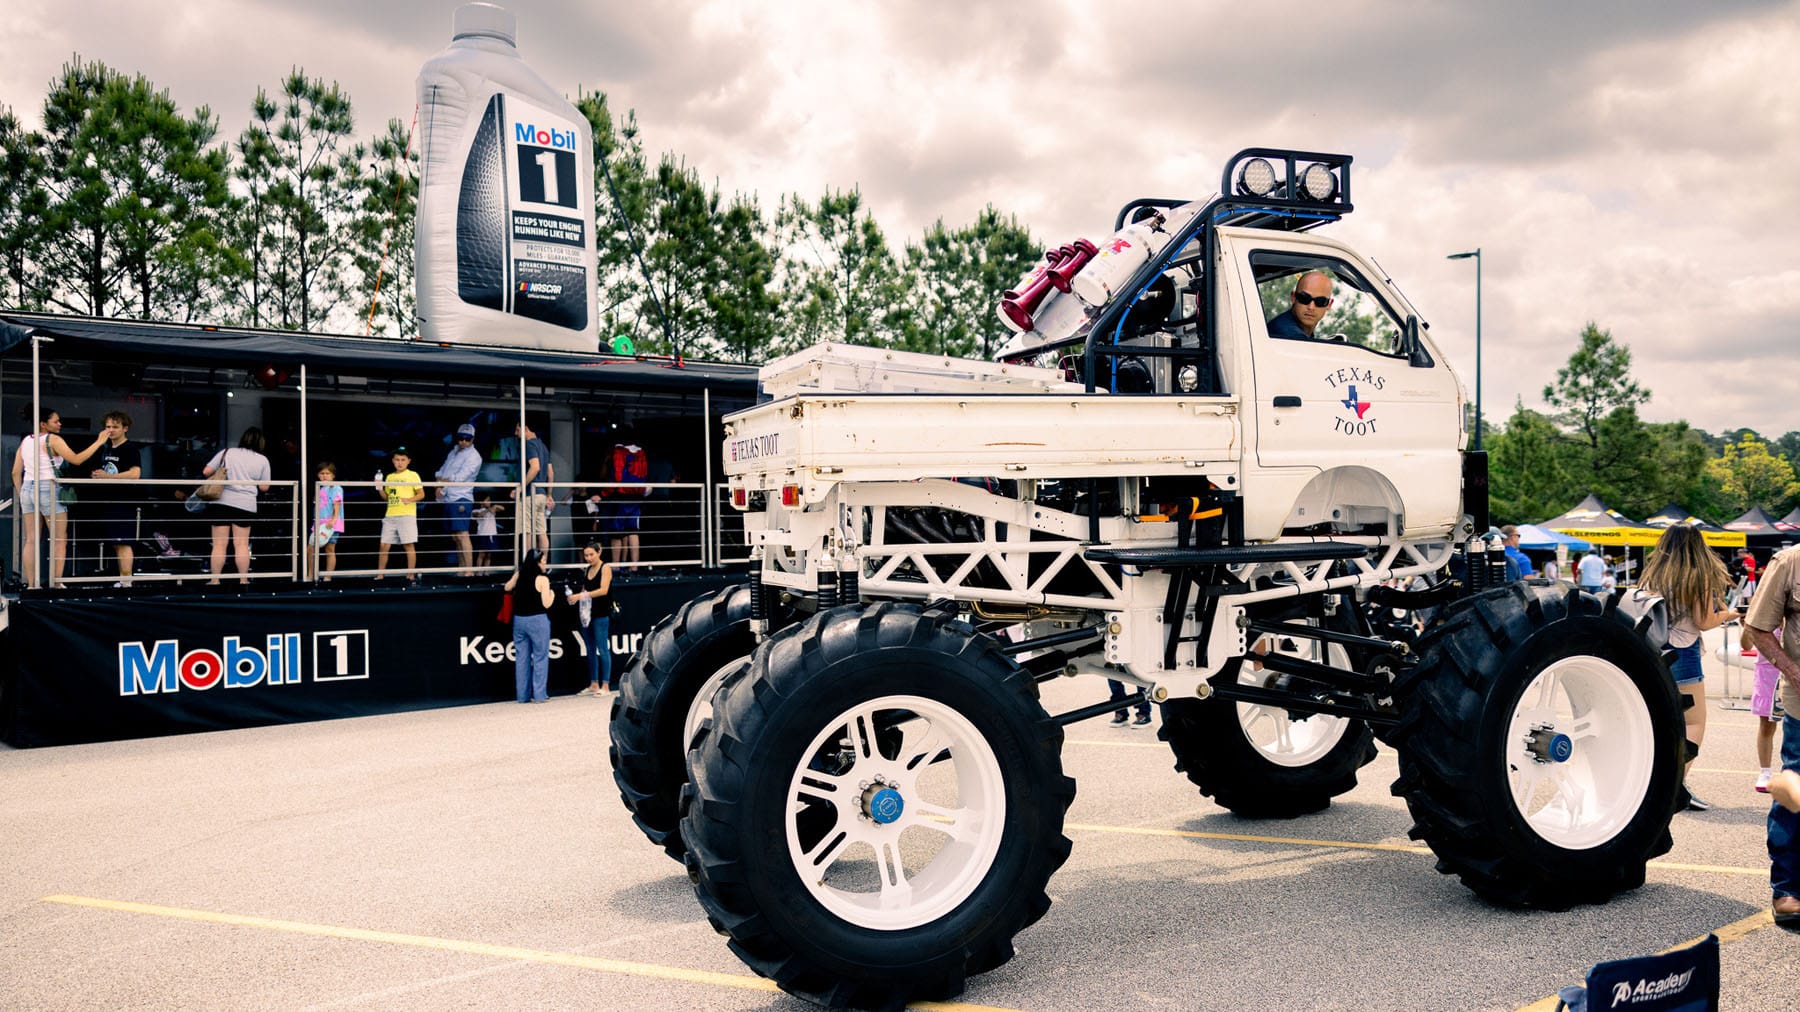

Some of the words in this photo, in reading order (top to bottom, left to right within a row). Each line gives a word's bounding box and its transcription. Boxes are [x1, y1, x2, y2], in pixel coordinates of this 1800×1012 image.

[515, 122, 576, 150] Mobil
[535, 150, 559, 204] 1
[514, 215, 538, 227] KEEPS
[538, 218, 558, 229] YOUR
[558, 220, 582, 233] ENGINE
[514, 225, 549, 237] RUNNING
[549, 229, 564, 239] LIKE
[565, 231, 580, 241] NEW
[518, 261, 547, 270] ADVANCED
[547, 263, 560, 272] FULL
[560, 266, 585, 275] SYNTHETIC
[529, 284, 562, 295] NASCAR
[1324, 367, 1386, 391] TEXAS
[1334, 416, 1377, 436] TOOT
[737, 437, 759, 461] TEXAS
[760, 433, 780, 457] TOOT
[460, 635, 564, 665] Kees
[571, 630, 643, 656] Yur
[119, 633, 301, 696] Mobil
[330, 635, 348, 675] 1
[1632, 966, 1696, 996] Academy
